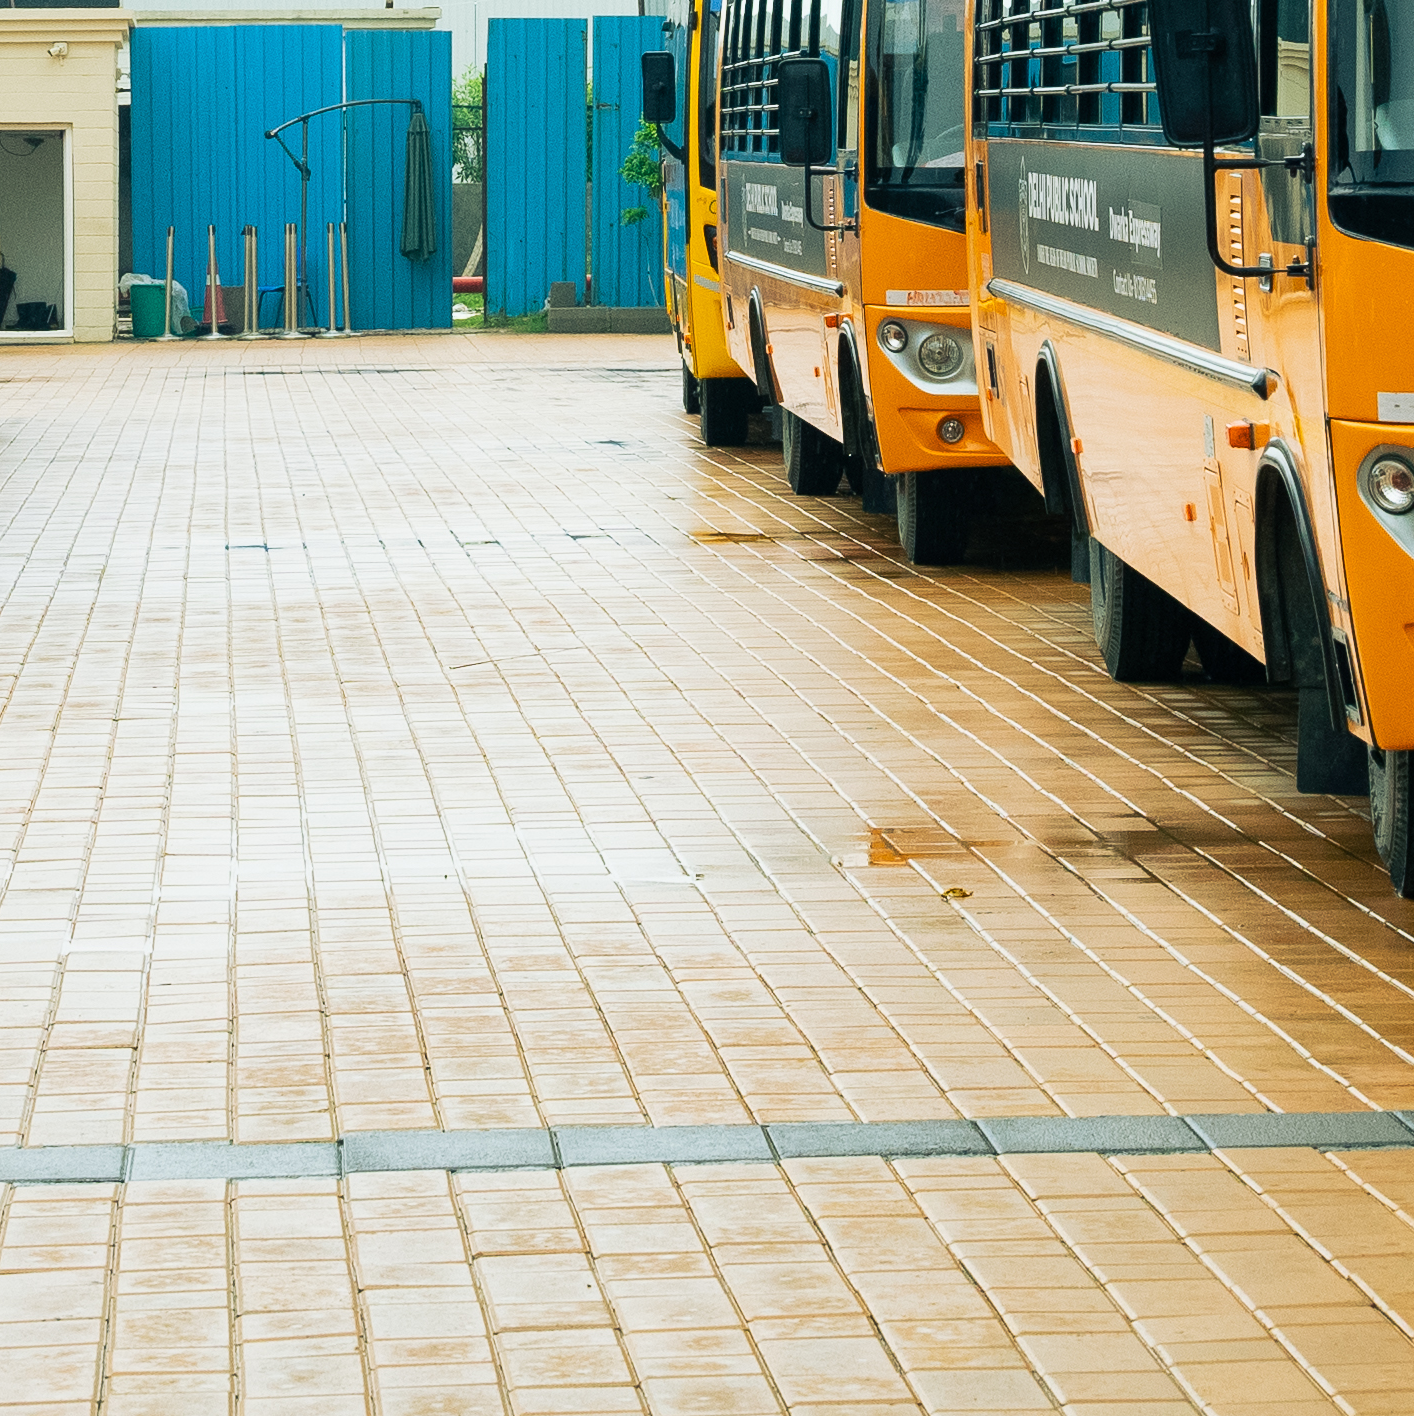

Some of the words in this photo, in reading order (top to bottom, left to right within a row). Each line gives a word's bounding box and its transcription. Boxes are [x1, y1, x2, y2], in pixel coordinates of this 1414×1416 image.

[1028, 171, 1047, 221] DELHI
[1047, 174, 1069, 226] PUBLIC
[1069, 177, 1100, 232] SCHOOL
